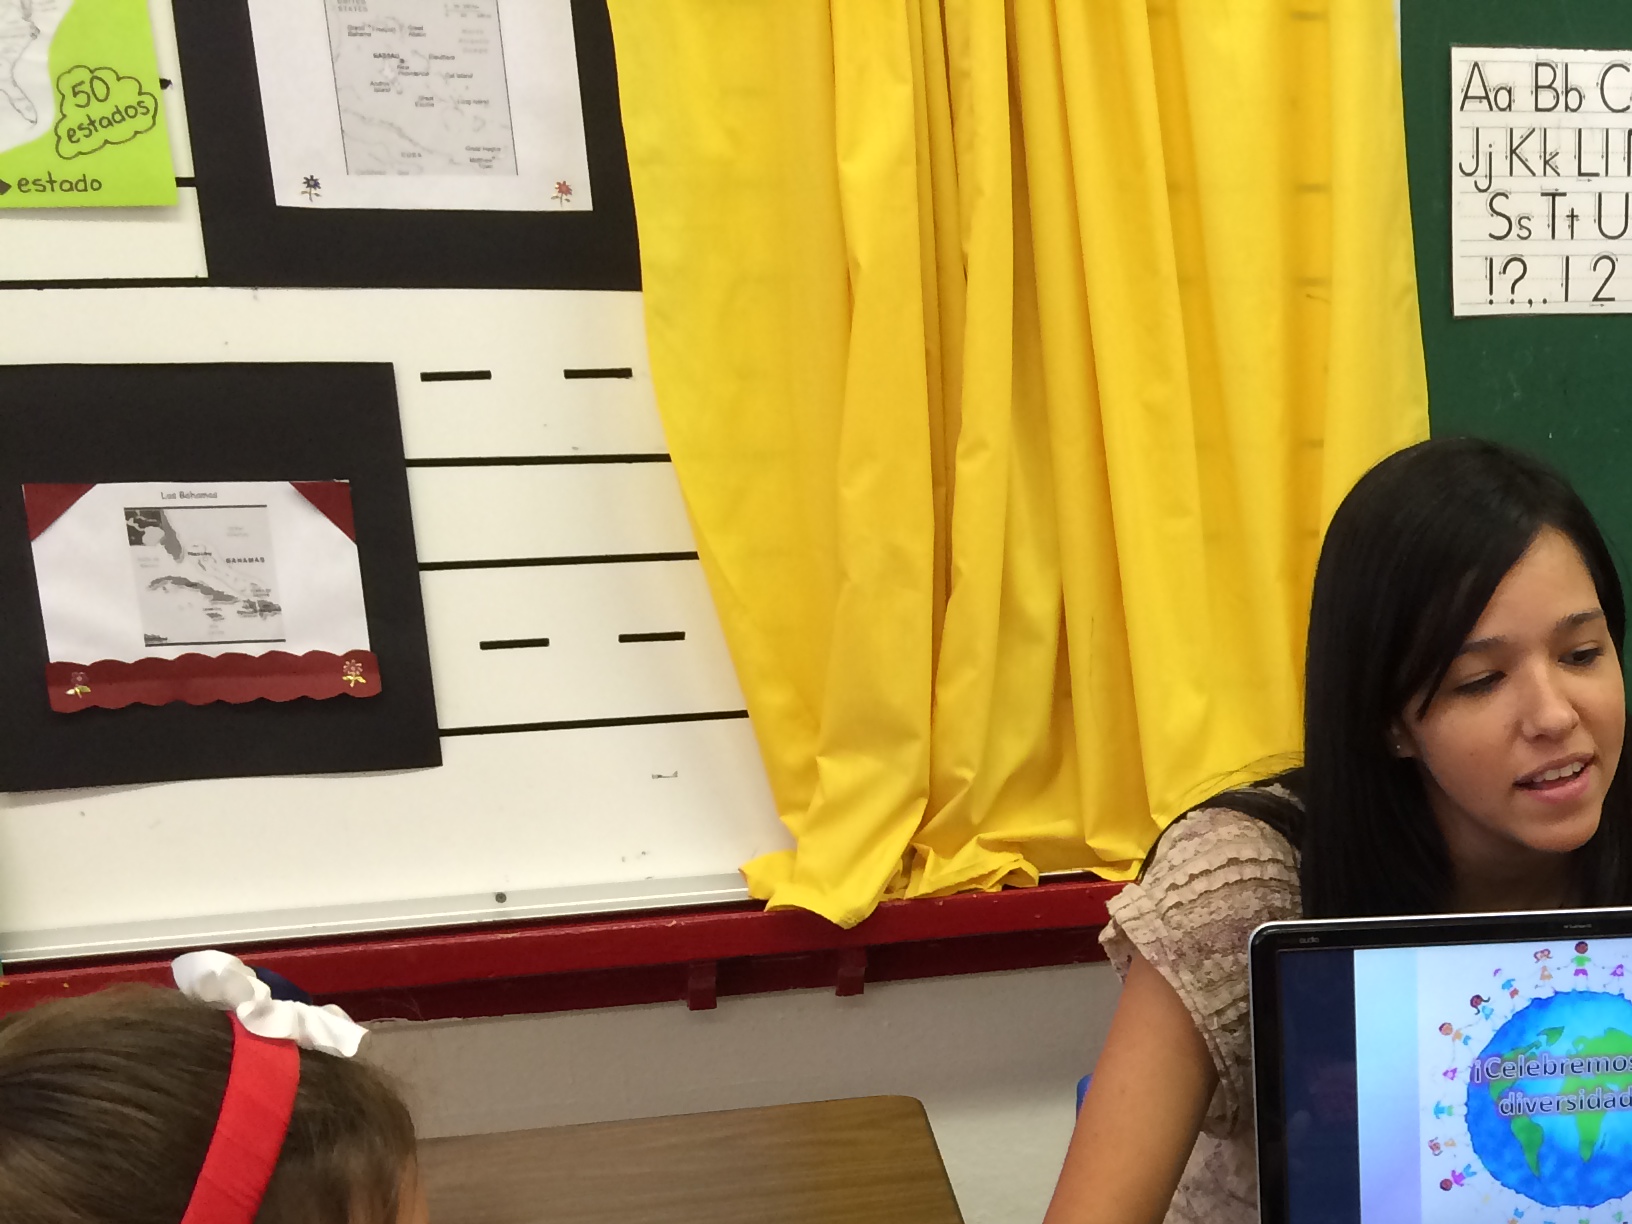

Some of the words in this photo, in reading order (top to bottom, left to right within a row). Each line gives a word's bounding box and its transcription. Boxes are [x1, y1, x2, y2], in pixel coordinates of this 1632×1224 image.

[71, 75, 110, 109] 50
[1460, 62, 1512, 113] Aa
[1534, 62, 1584, 113] Bb
[66, 100, 150, 144] estados
[17, 170, 103, 194] estado
[1459, 128, 1494, 192] Jj
[1509, 127, 1560, 177] Kk
[1488, 191, 1532, 240] Ss
[1540, 192, 1580, 240] Tt
[1592, 254, 1617, 303] 2
[160, 491, 177, 500] Las
[179, 490, 218, 499] Bahamas
